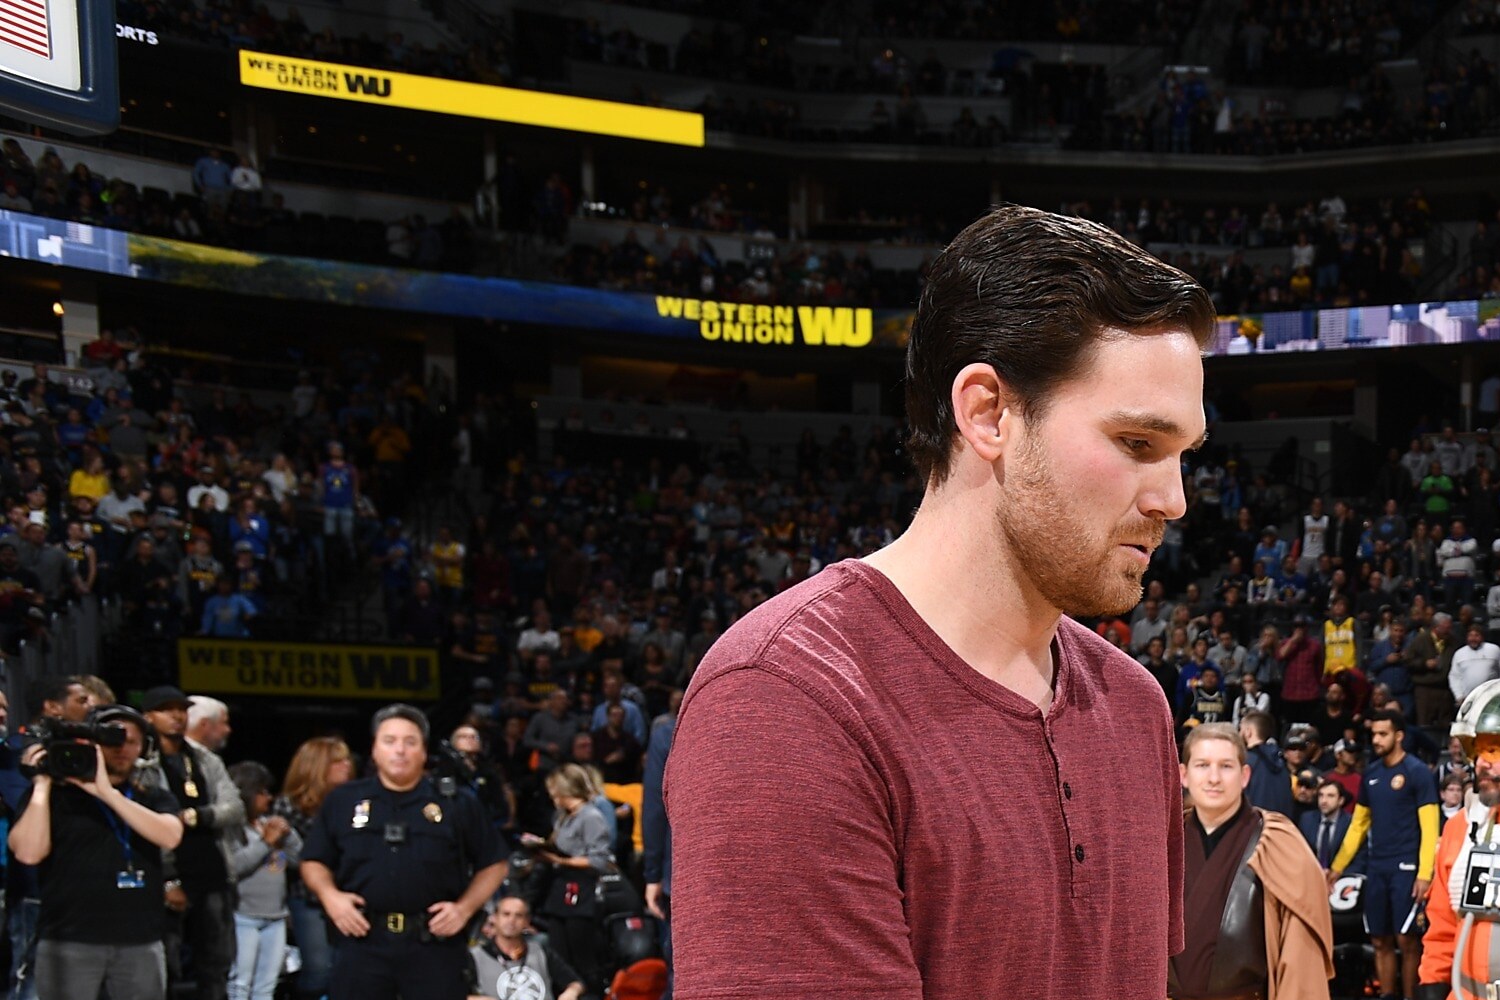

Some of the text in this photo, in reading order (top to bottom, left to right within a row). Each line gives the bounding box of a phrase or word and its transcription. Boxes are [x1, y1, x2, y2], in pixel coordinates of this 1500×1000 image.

[247, 58, 338, 80] WESTERN
[277, 74, 338, 91] UNION
[344, 72, 391, 97] WU
[655, 296, 794, 325] WESTERN
[700, 319, 794, 345] UNION
[797, 306, 873, 347] WU
[188, 647, 341, 670] WESTERN
[237, 668, 341, 689] UNION
[350, 655, 431, 690] WU
[1328, 877, 1362, 910] G
